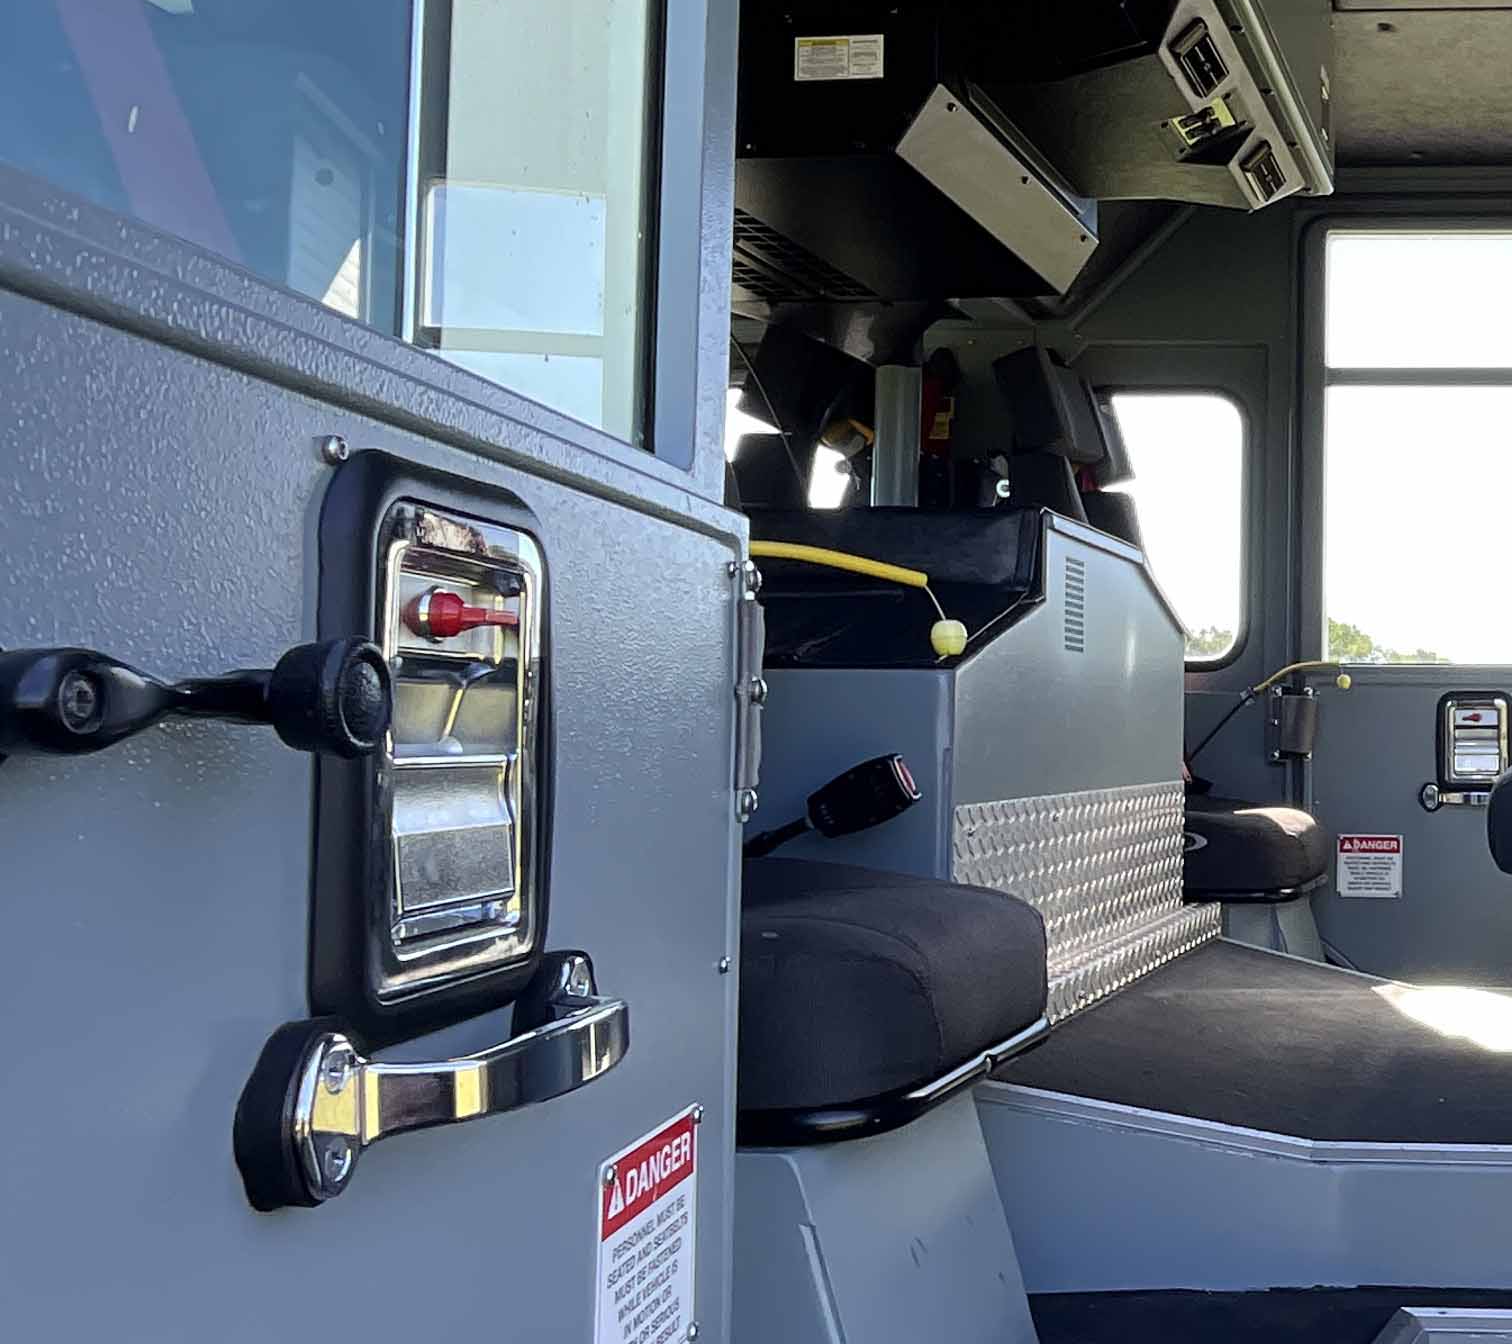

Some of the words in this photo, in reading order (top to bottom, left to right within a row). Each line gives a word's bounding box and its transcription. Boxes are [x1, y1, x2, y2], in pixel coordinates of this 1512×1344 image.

[1353, 839, 1398, 851] DANGER
[626, 1131, 691, 1206] DANGER
[607, 1255, 636, 1289] SEATED
[637, 1242, 652, 1264] AND
[653, 1211, 688, 1249] SEATBELTS
[612, 1219, 656, 1264] PERSONNEL
[657, 1202, 675, 1227] MUST
[676, 1194, 686, 1211] BE
[614, 1275, 636, 1304] MUST
[637, 1266, 647, 1286] BE
[648, 1237, 682, 1274] FASTENED
[618, 1289, 641, 1323] WHILE
[641, 1265, 671, 1301] VEHICLE
[671, 1258, 679, 1275] IS
[624, 1320, 632, 1340] IN
[633, 1297, 661, 1330] MOTION
[662, 1284, 672, 1304] OR
[639, 1324, 650, 1344] OR
[650, 1296, 680, 1335] SERIOUS
